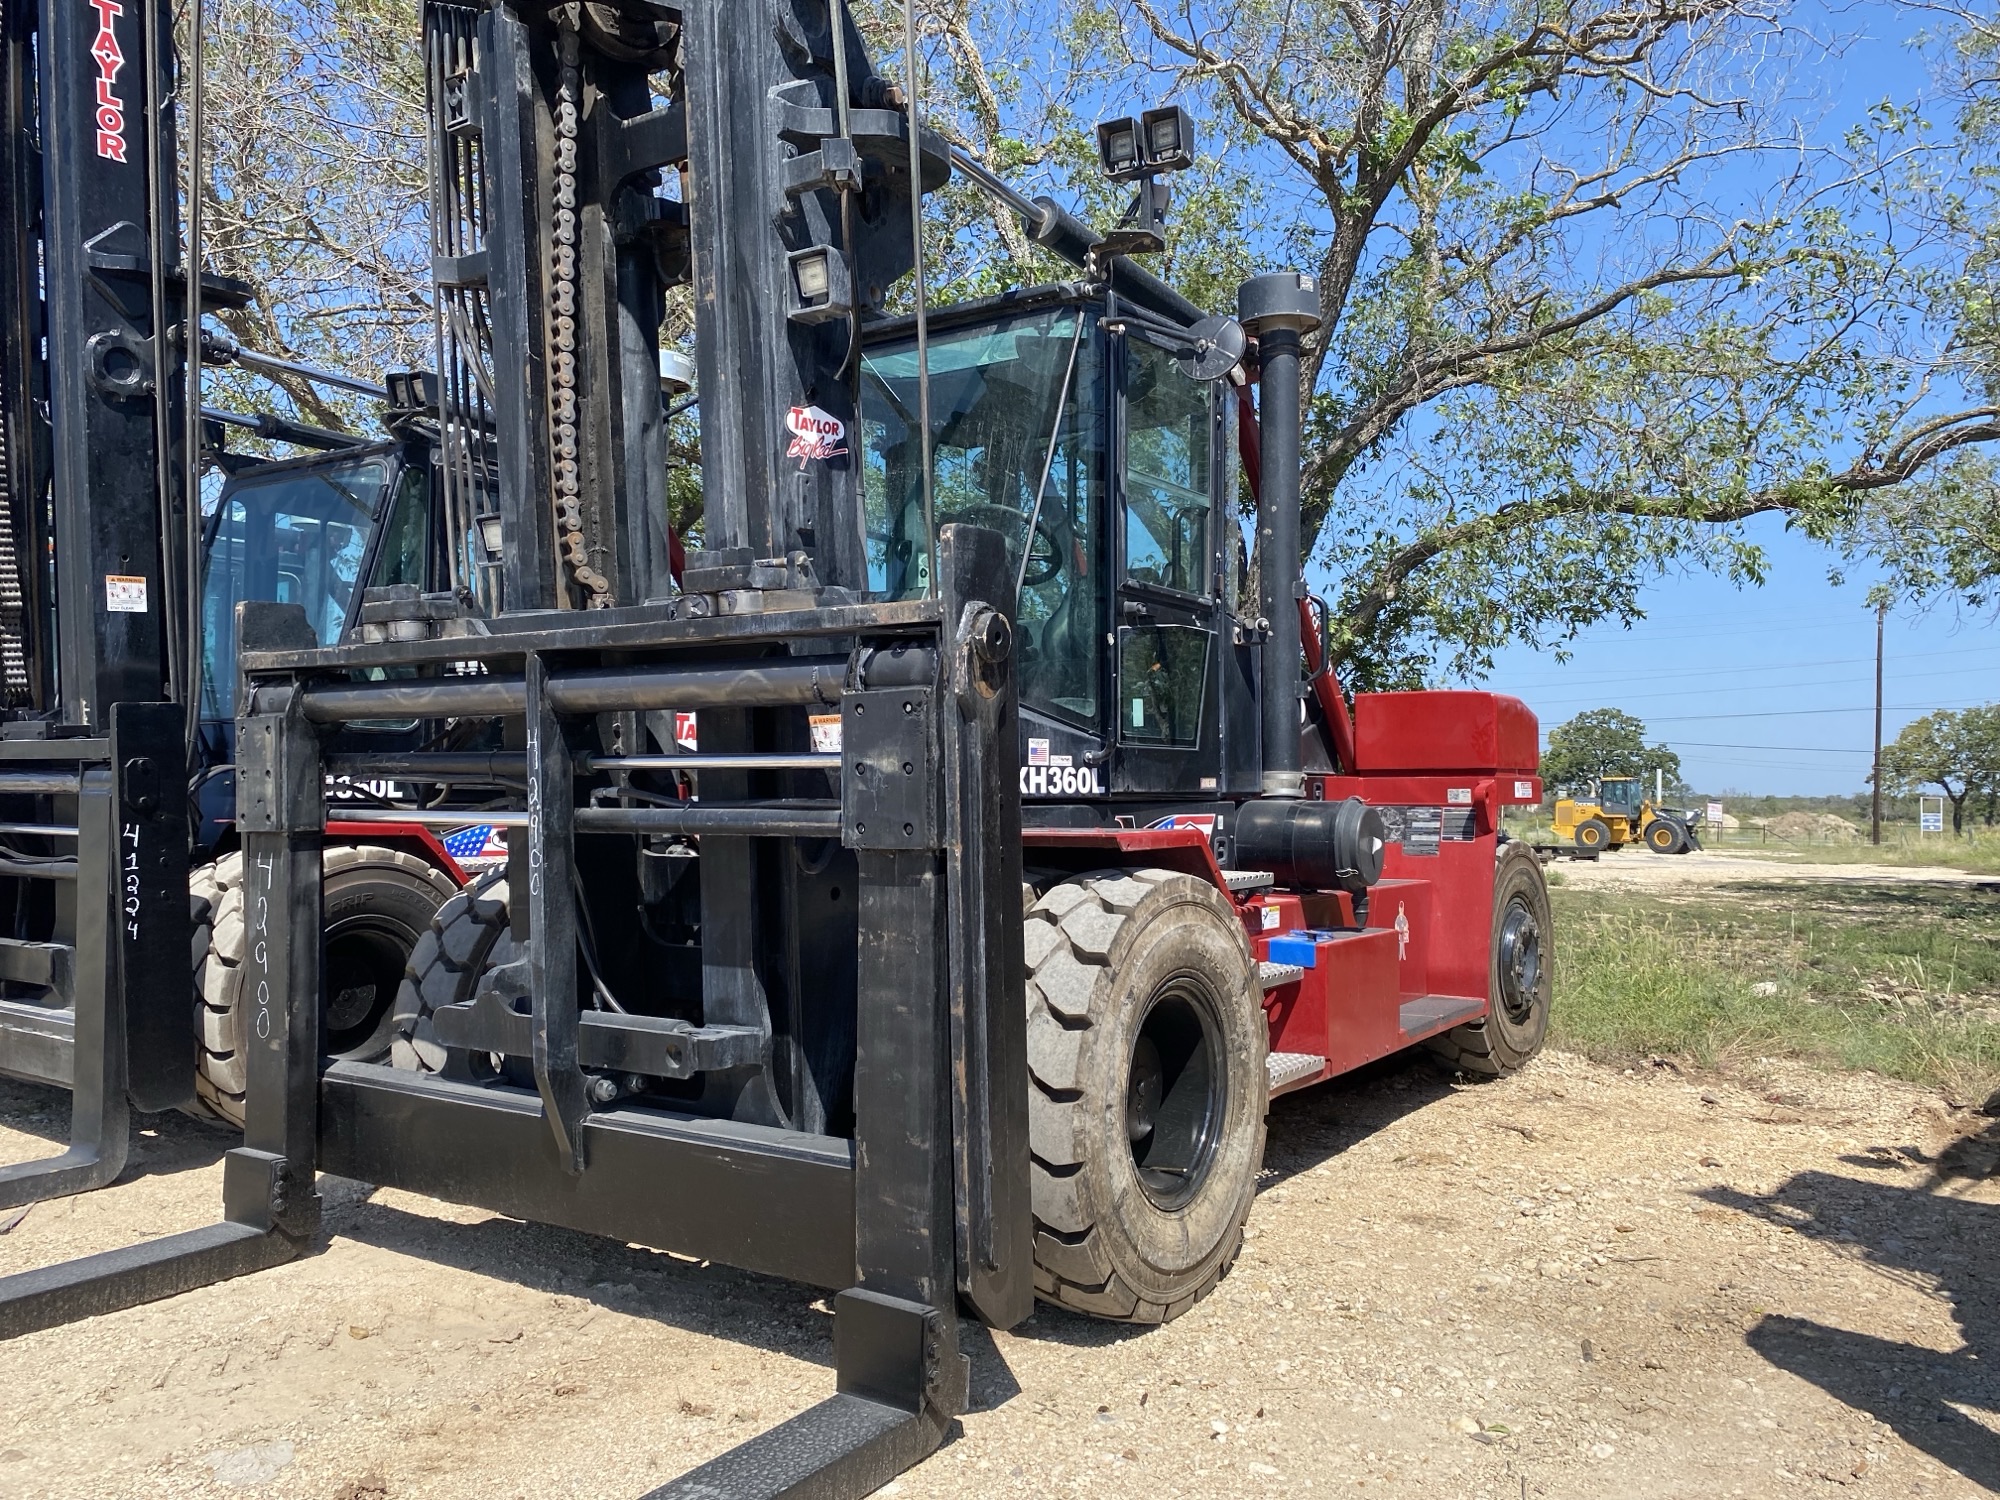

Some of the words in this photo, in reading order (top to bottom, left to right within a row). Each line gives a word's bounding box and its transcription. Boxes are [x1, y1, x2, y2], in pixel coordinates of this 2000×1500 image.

[90, 0, 127, 163] TAYLOR
[787, 435, 812, 470] Big
[791, 407, 840, 437] TAYLOR
[122, 822, 140, 940] 41224
[255, 851, 274, 1039] 42900
